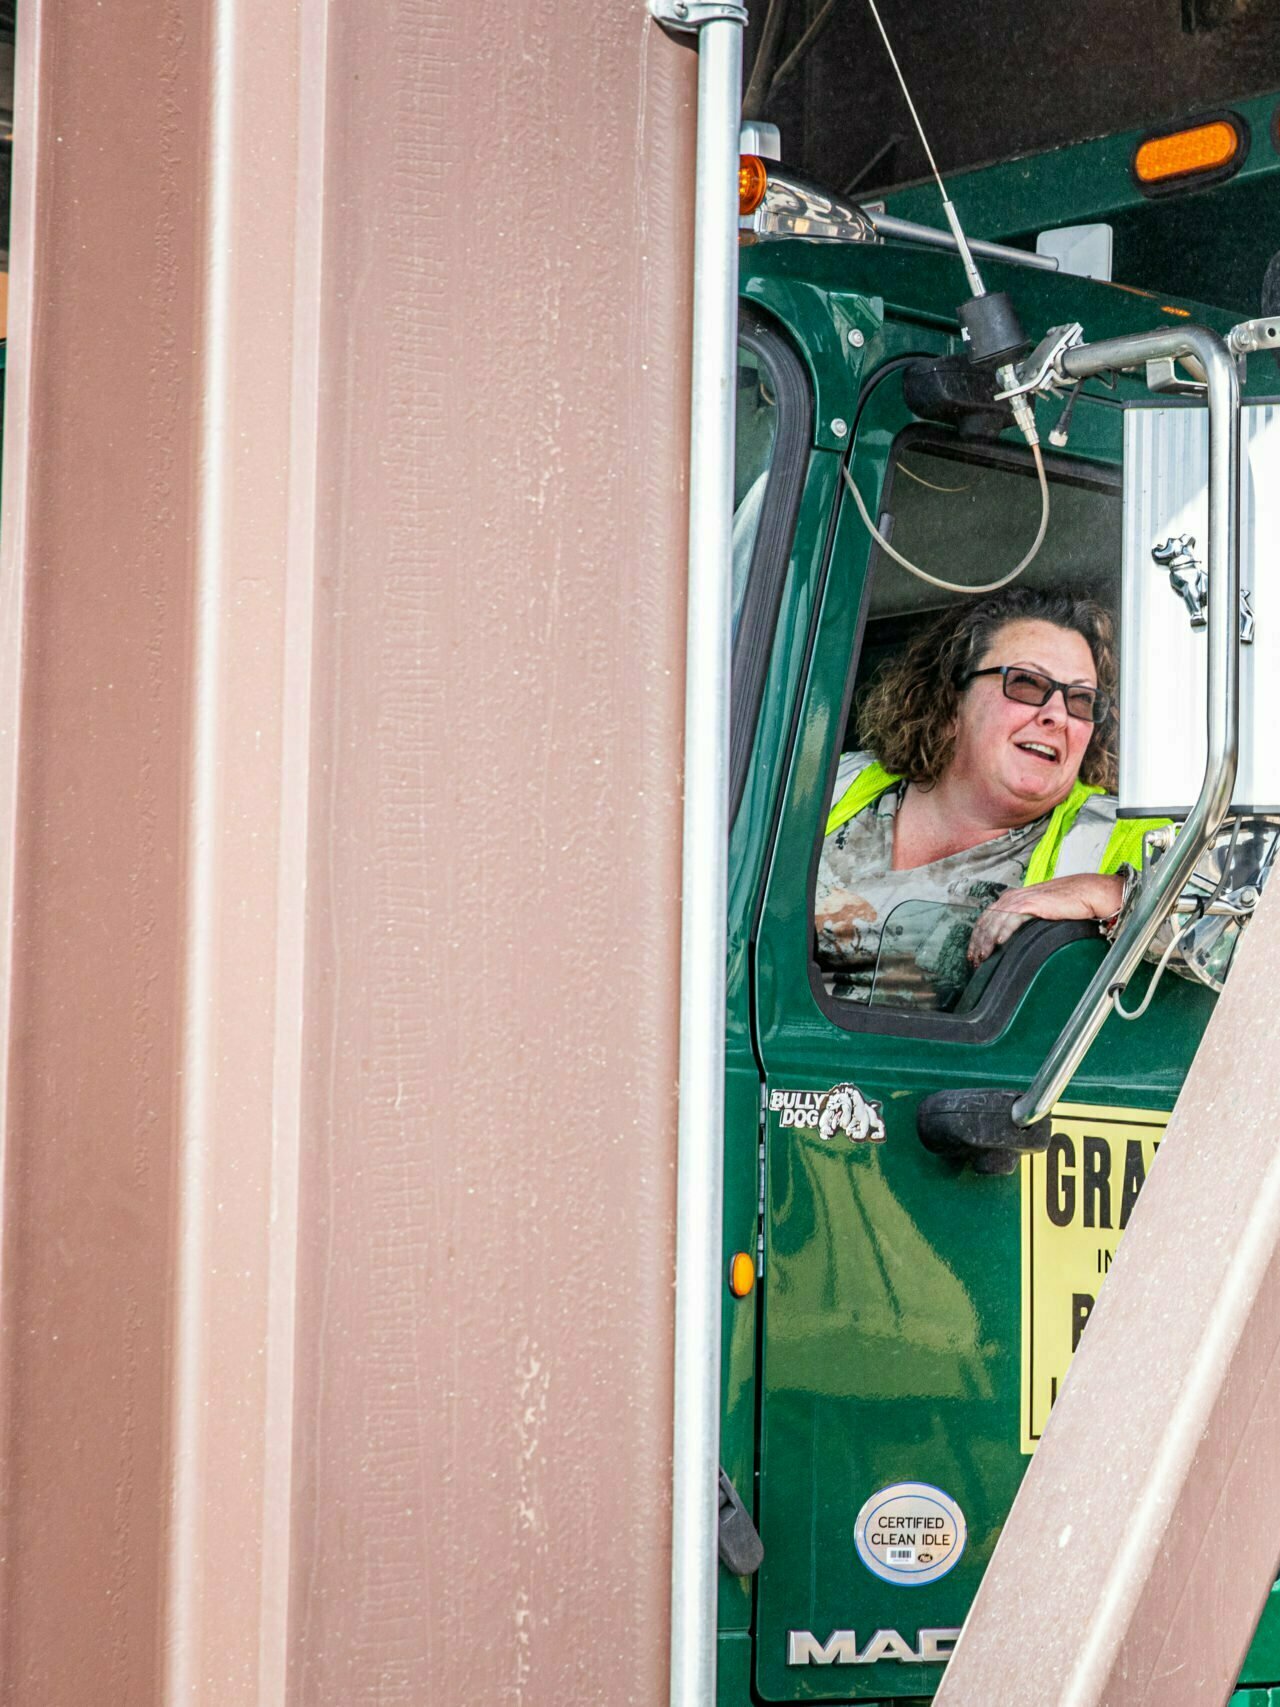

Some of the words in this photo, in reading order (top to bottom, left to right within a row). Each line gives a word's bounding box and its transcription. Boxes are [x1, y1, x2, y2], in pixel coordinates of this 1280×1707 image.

[771, 1092, 828, 1110] BULLY
[782, 1109, 819, 1128] DOG
[1046, 1133, 1160, 1230] GRA
[878, 1516, 944, 1529] CERTIFIED
[871, 1533, 915, 1546] CLEAN
[922, 1534, 950, 1546] IDLE
